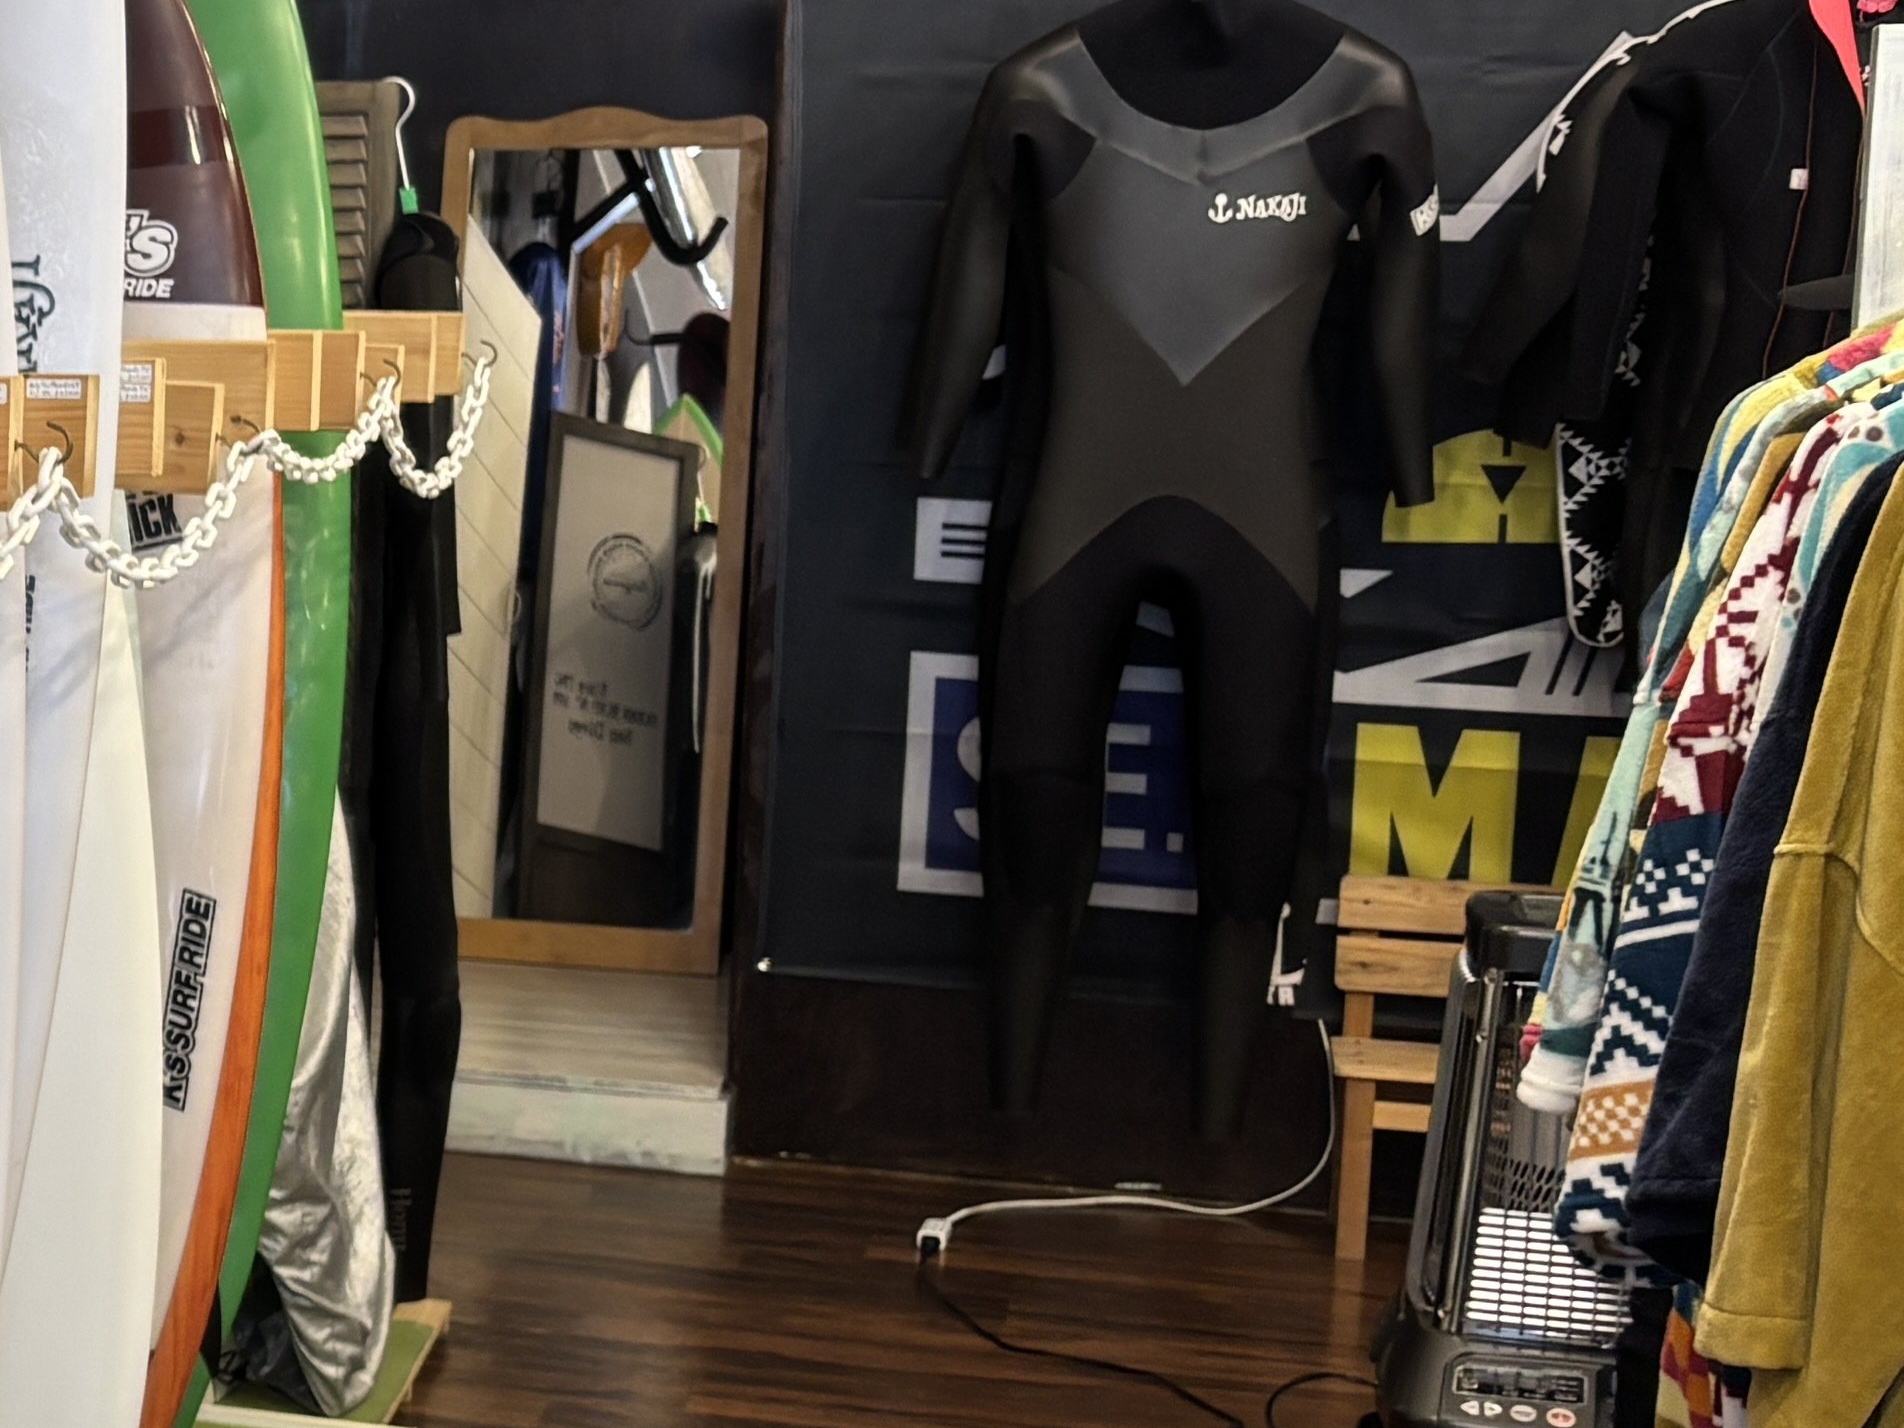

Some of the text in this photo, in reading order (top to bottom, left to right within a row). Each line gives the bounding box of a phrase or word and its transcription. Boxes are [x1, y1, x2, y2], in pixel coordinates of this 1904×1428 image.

[1236, 192, 1307, 222] NAKAJI
[123, 277, 175, 300] RIDE
[175, 896, 212, 974] RIDE
[166, 972, 202, 1053] SURF
